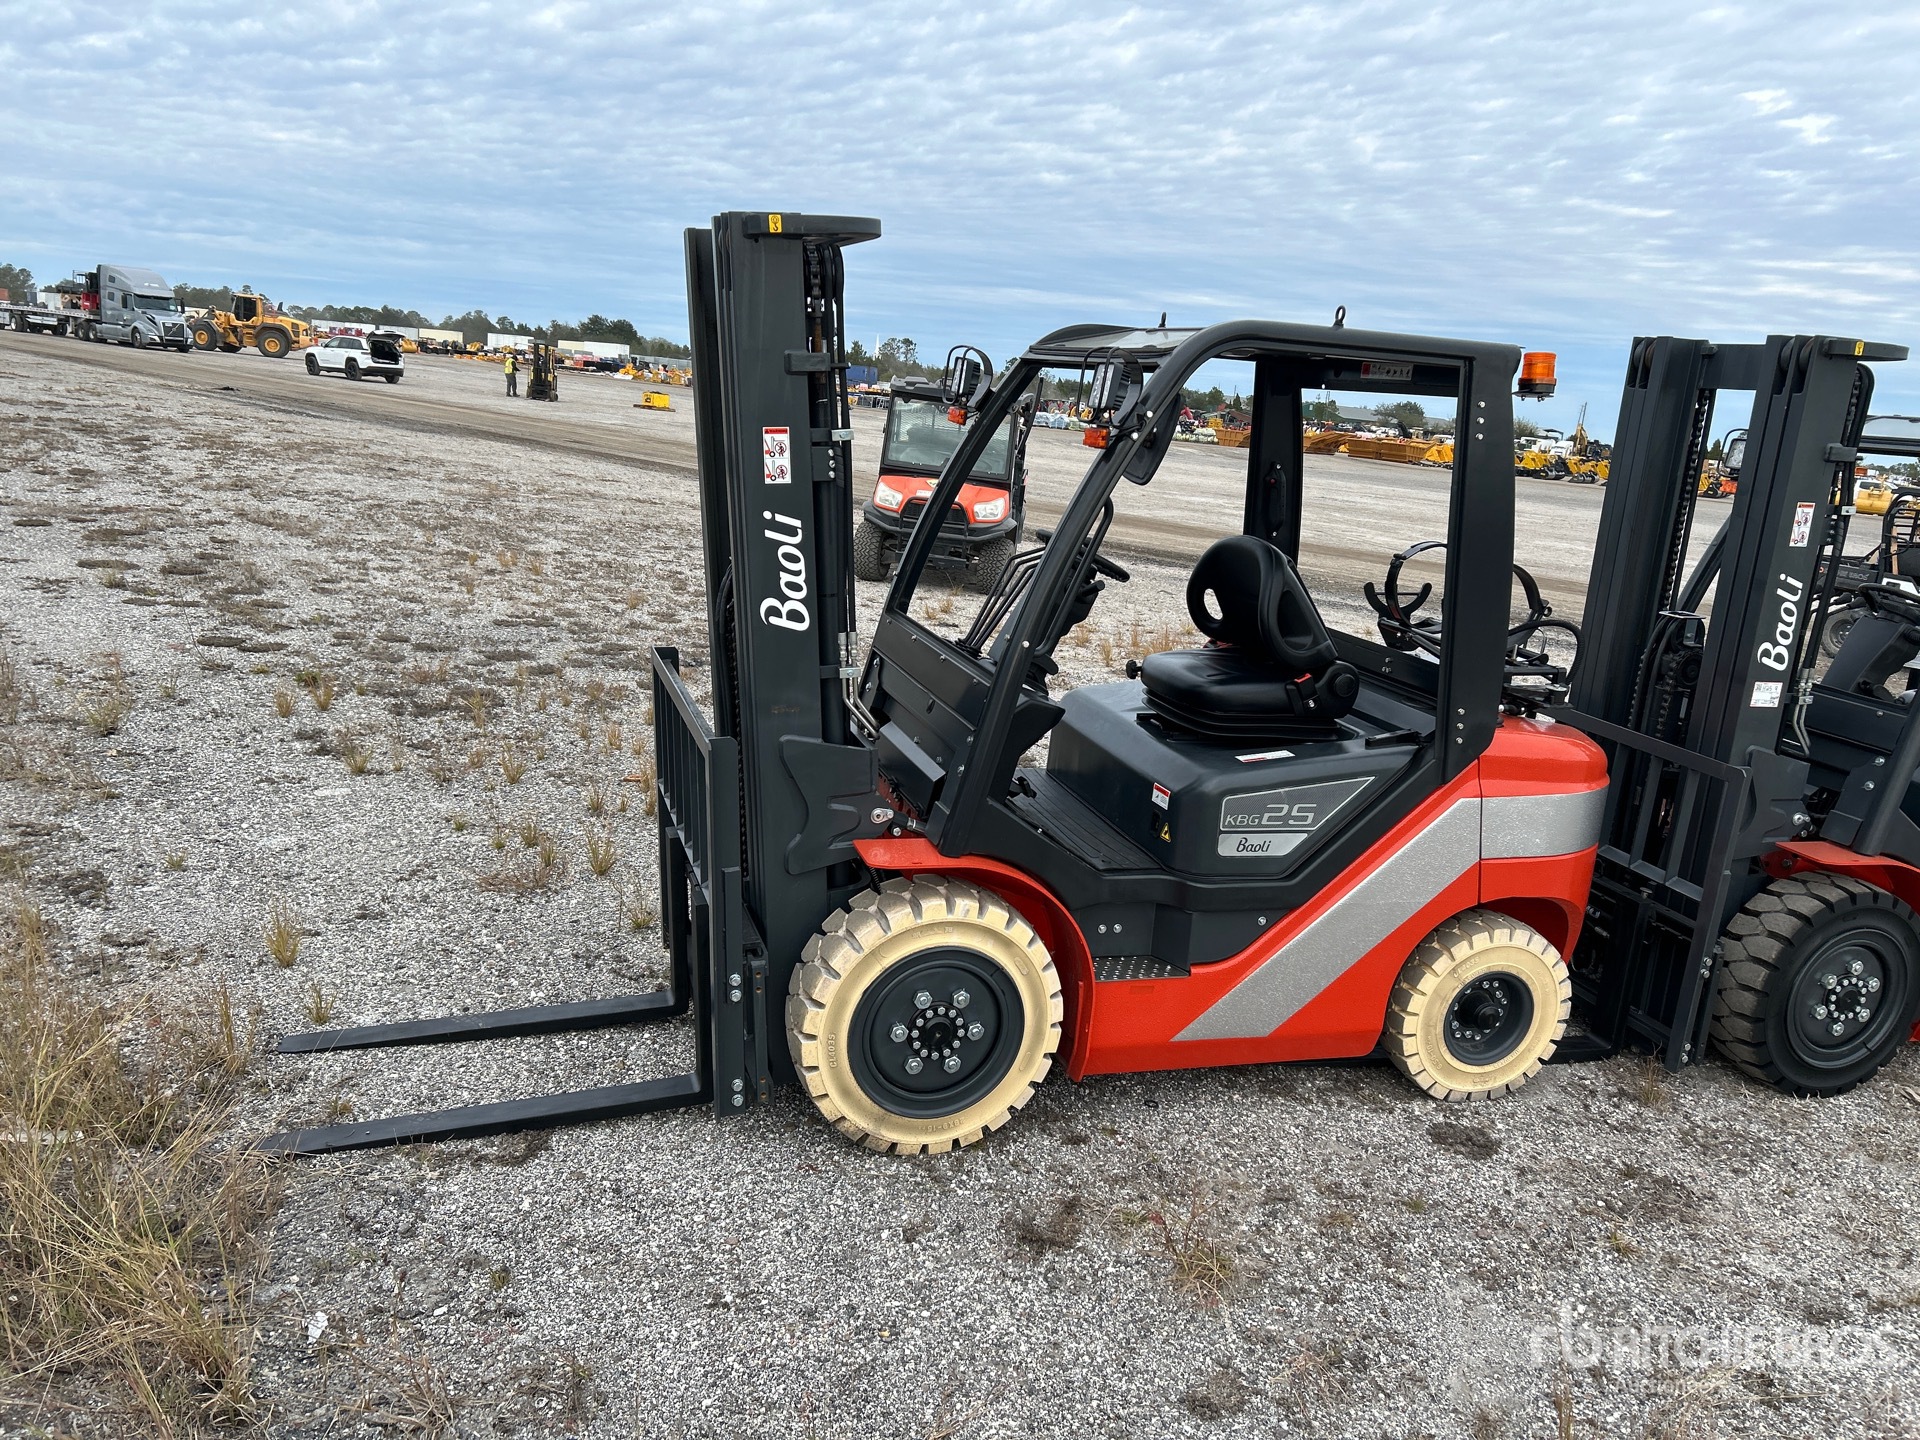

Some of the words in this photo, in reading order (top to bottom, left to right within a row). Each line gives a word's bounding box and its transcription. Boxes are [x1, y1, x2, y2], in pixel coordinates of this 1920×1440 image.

[760, 510, 810, 631] Baoli
[1757, 573, 1804, 671] Baoli
[1236, 837, 1272, 852] Baoli
